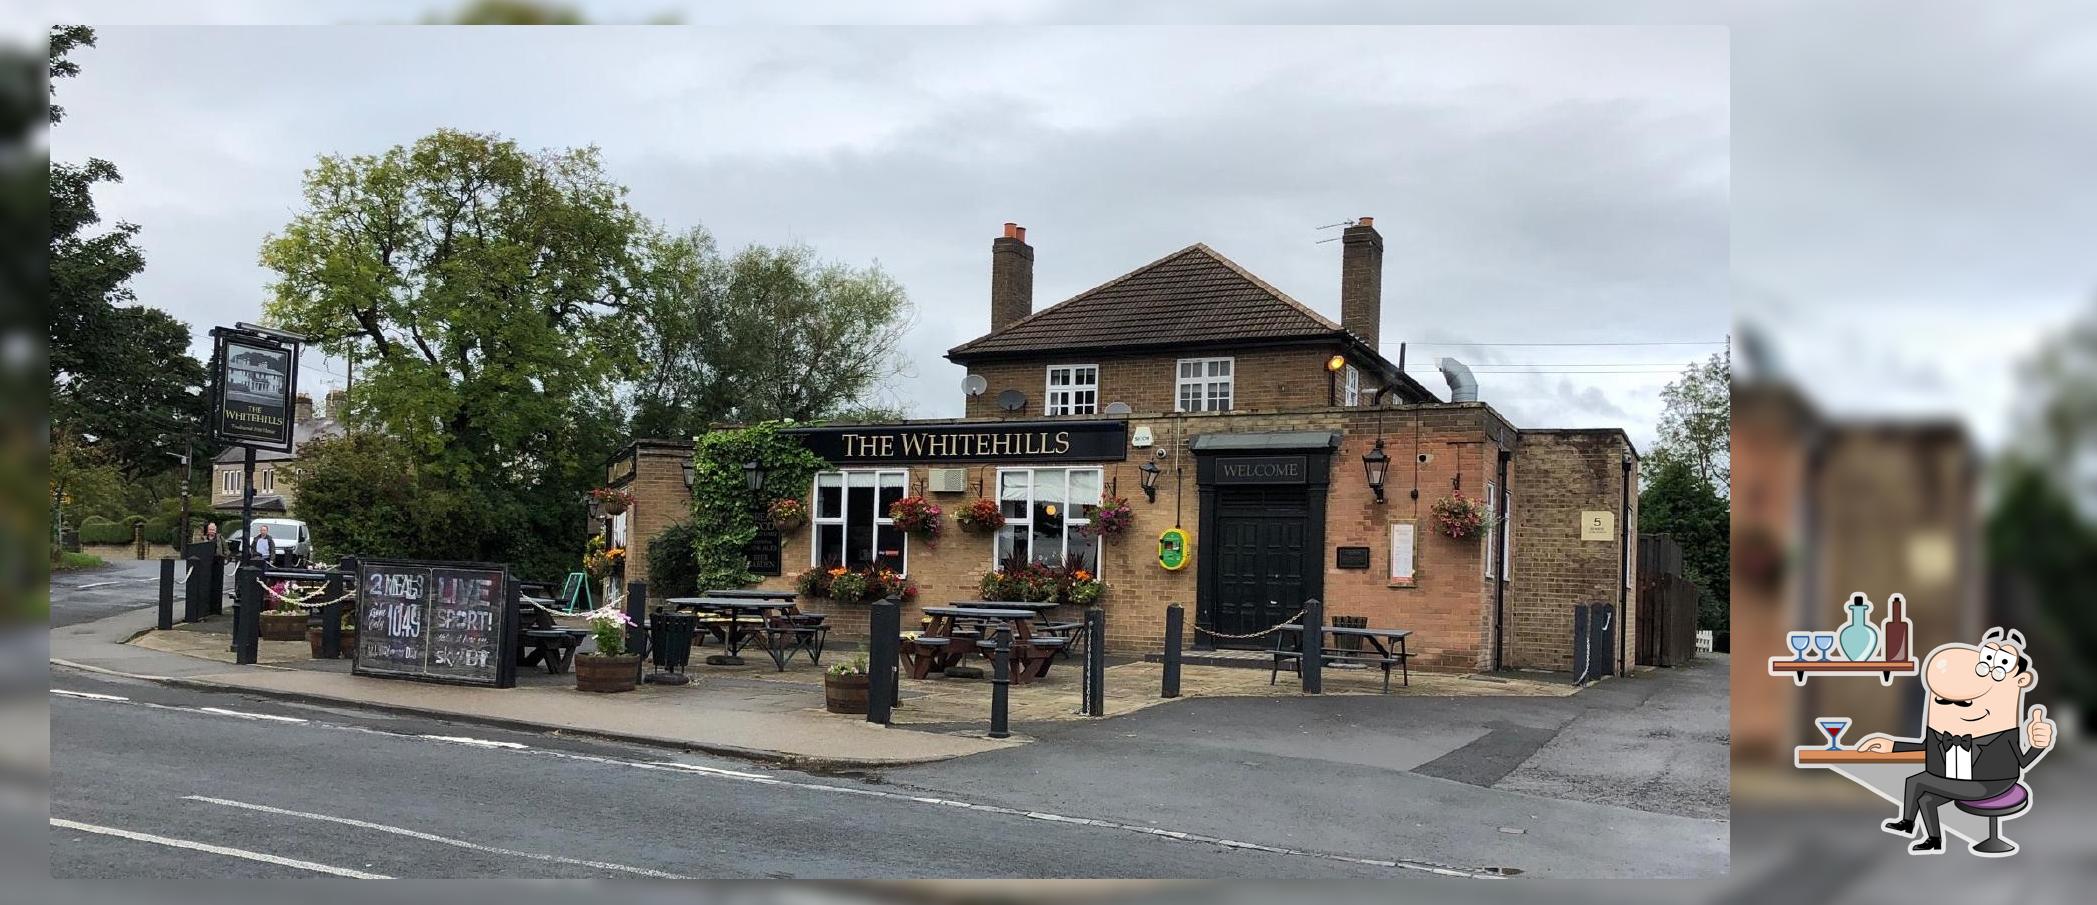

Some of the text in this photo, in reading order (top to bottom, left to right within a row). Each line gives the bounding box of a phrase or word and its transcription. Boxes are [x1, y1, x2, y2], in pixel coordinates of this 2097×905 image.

[225, 409, 283, 425] WHITEHILLS
[248, 405, 262, 413] THE
[841, 431, 1071, 457] THE WHITEHILLS
[1223, 463, 1299, 478] WELCOME
[1593, 517, 1602, 527] 5
[369, 573, 425, 600] 2 MEALS
[438, 576, 493, 607] LIVE
[437, 608, 493, 631] SPORT!
